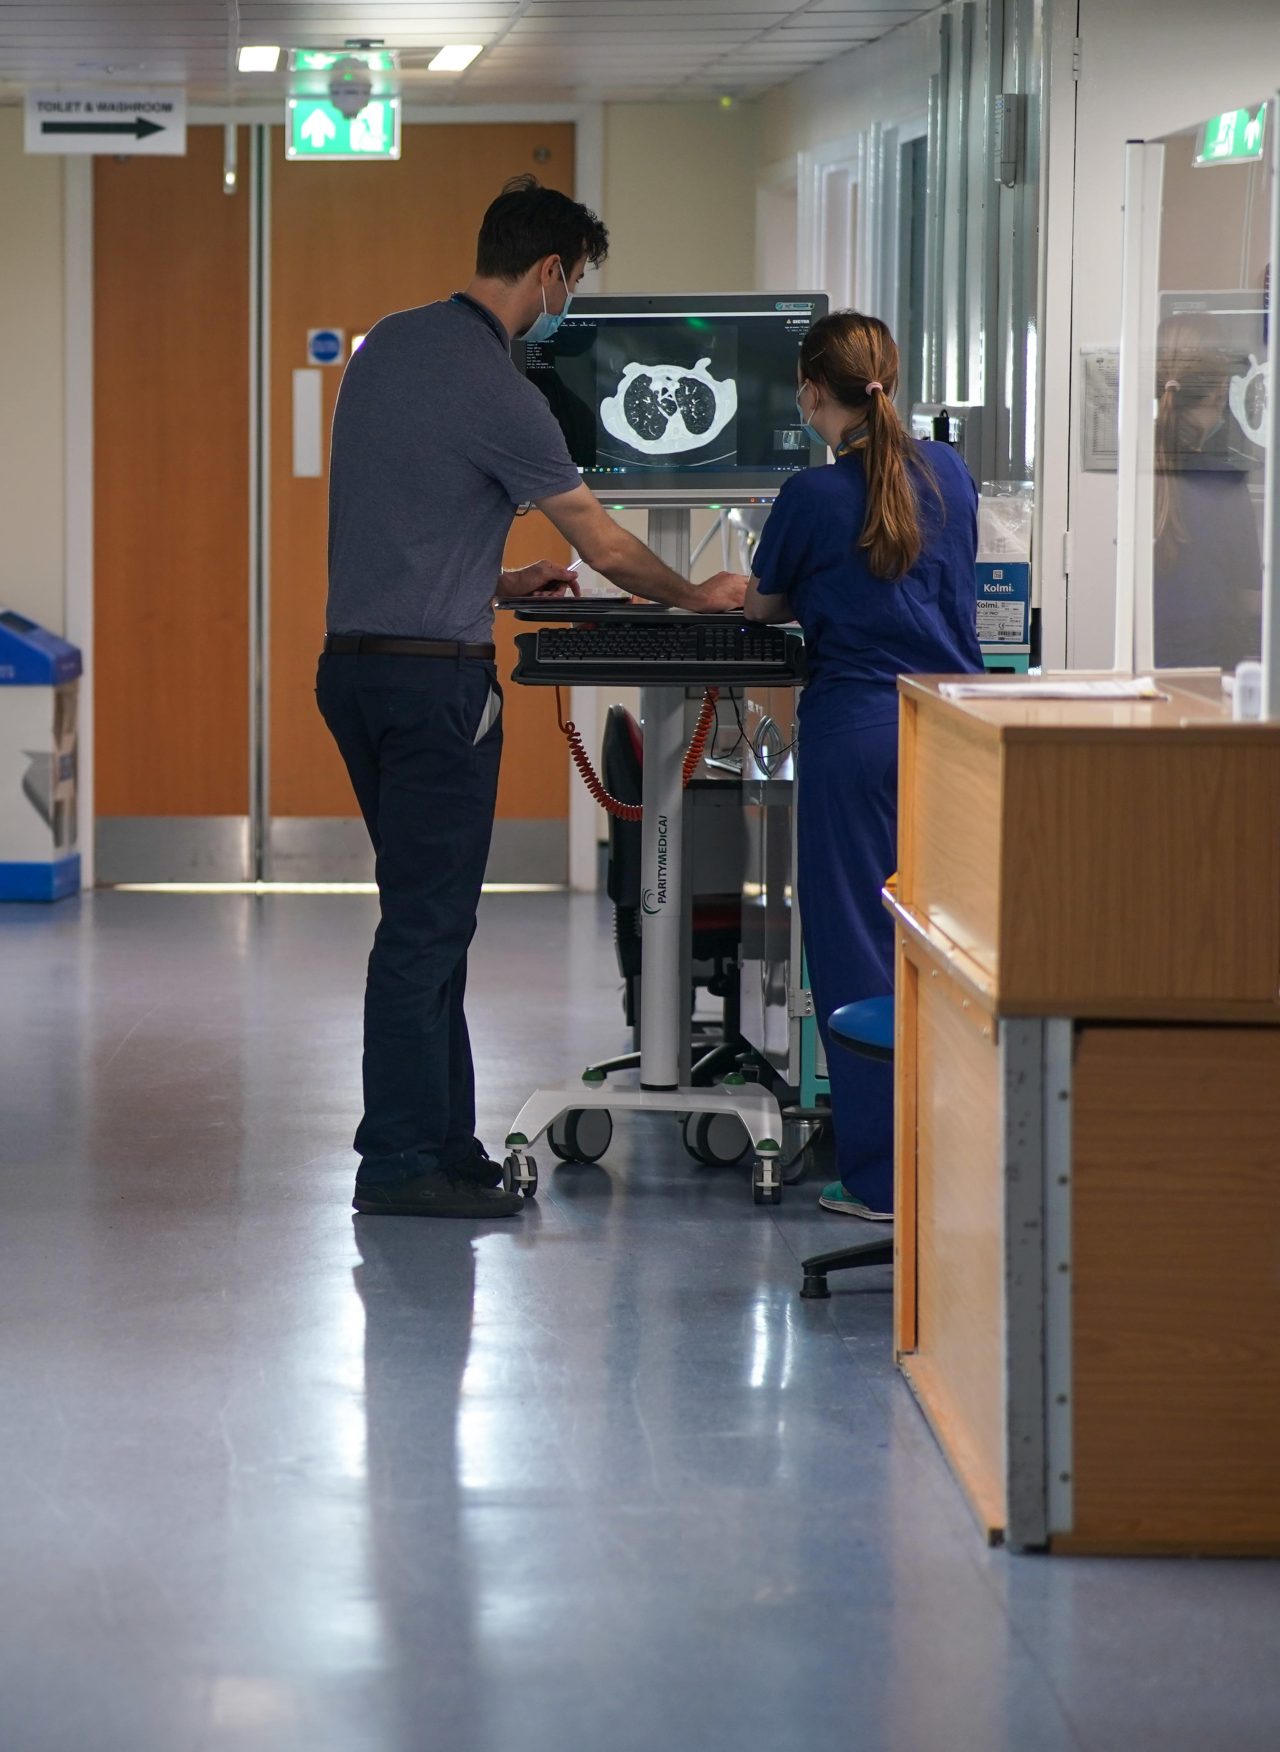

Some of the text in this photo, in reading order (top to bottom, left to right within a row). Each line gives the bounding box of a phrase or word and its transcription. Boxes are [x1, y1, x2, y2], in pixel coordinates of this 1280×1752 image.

[37, 101, 173, 112] TOILET & WASHROOM
